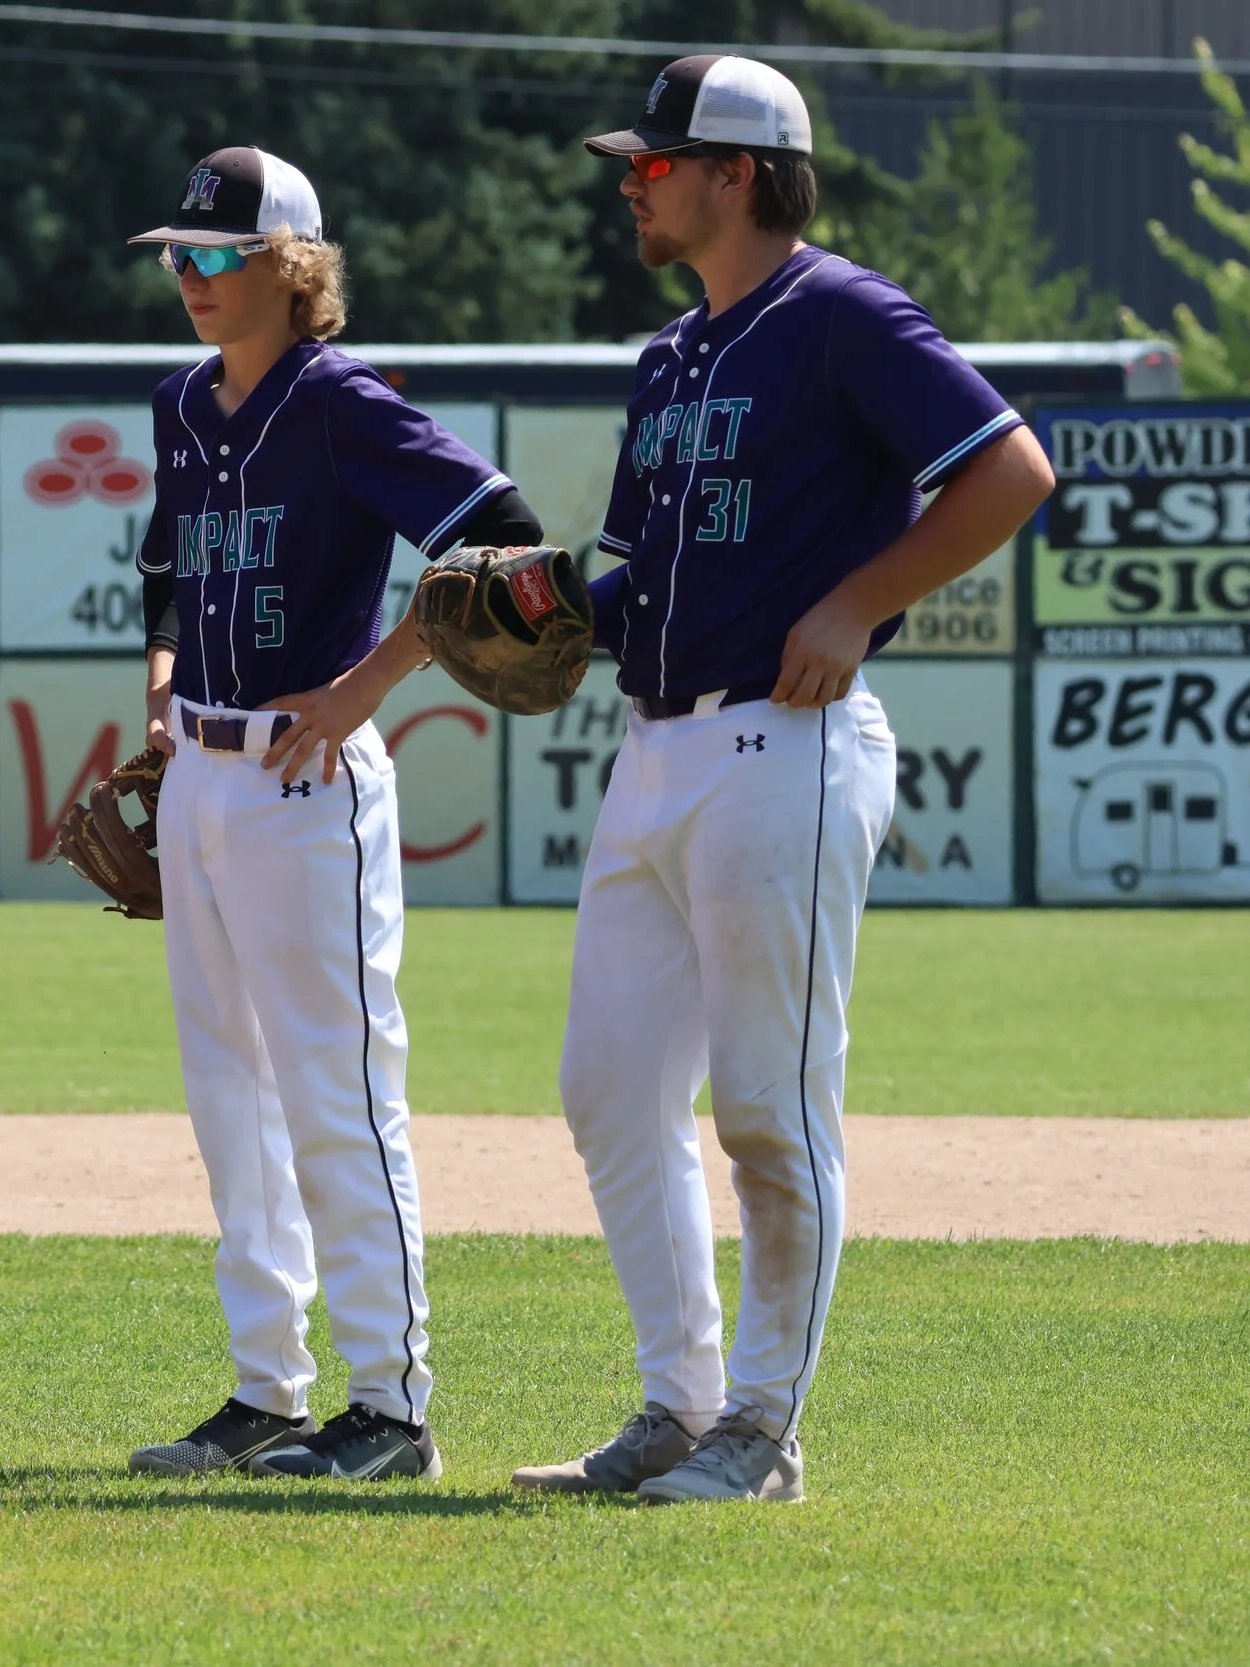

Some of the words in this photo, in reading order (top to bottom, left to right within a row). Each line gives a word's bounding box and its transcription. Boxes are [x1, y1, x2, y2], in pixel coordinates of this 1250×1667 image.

[632, 397, 752, 479] IMPACT
[176, 505, 285, 577] IMPACT
[695, 478, 751, 542] 31
[255, 585, 284, 648] 5
